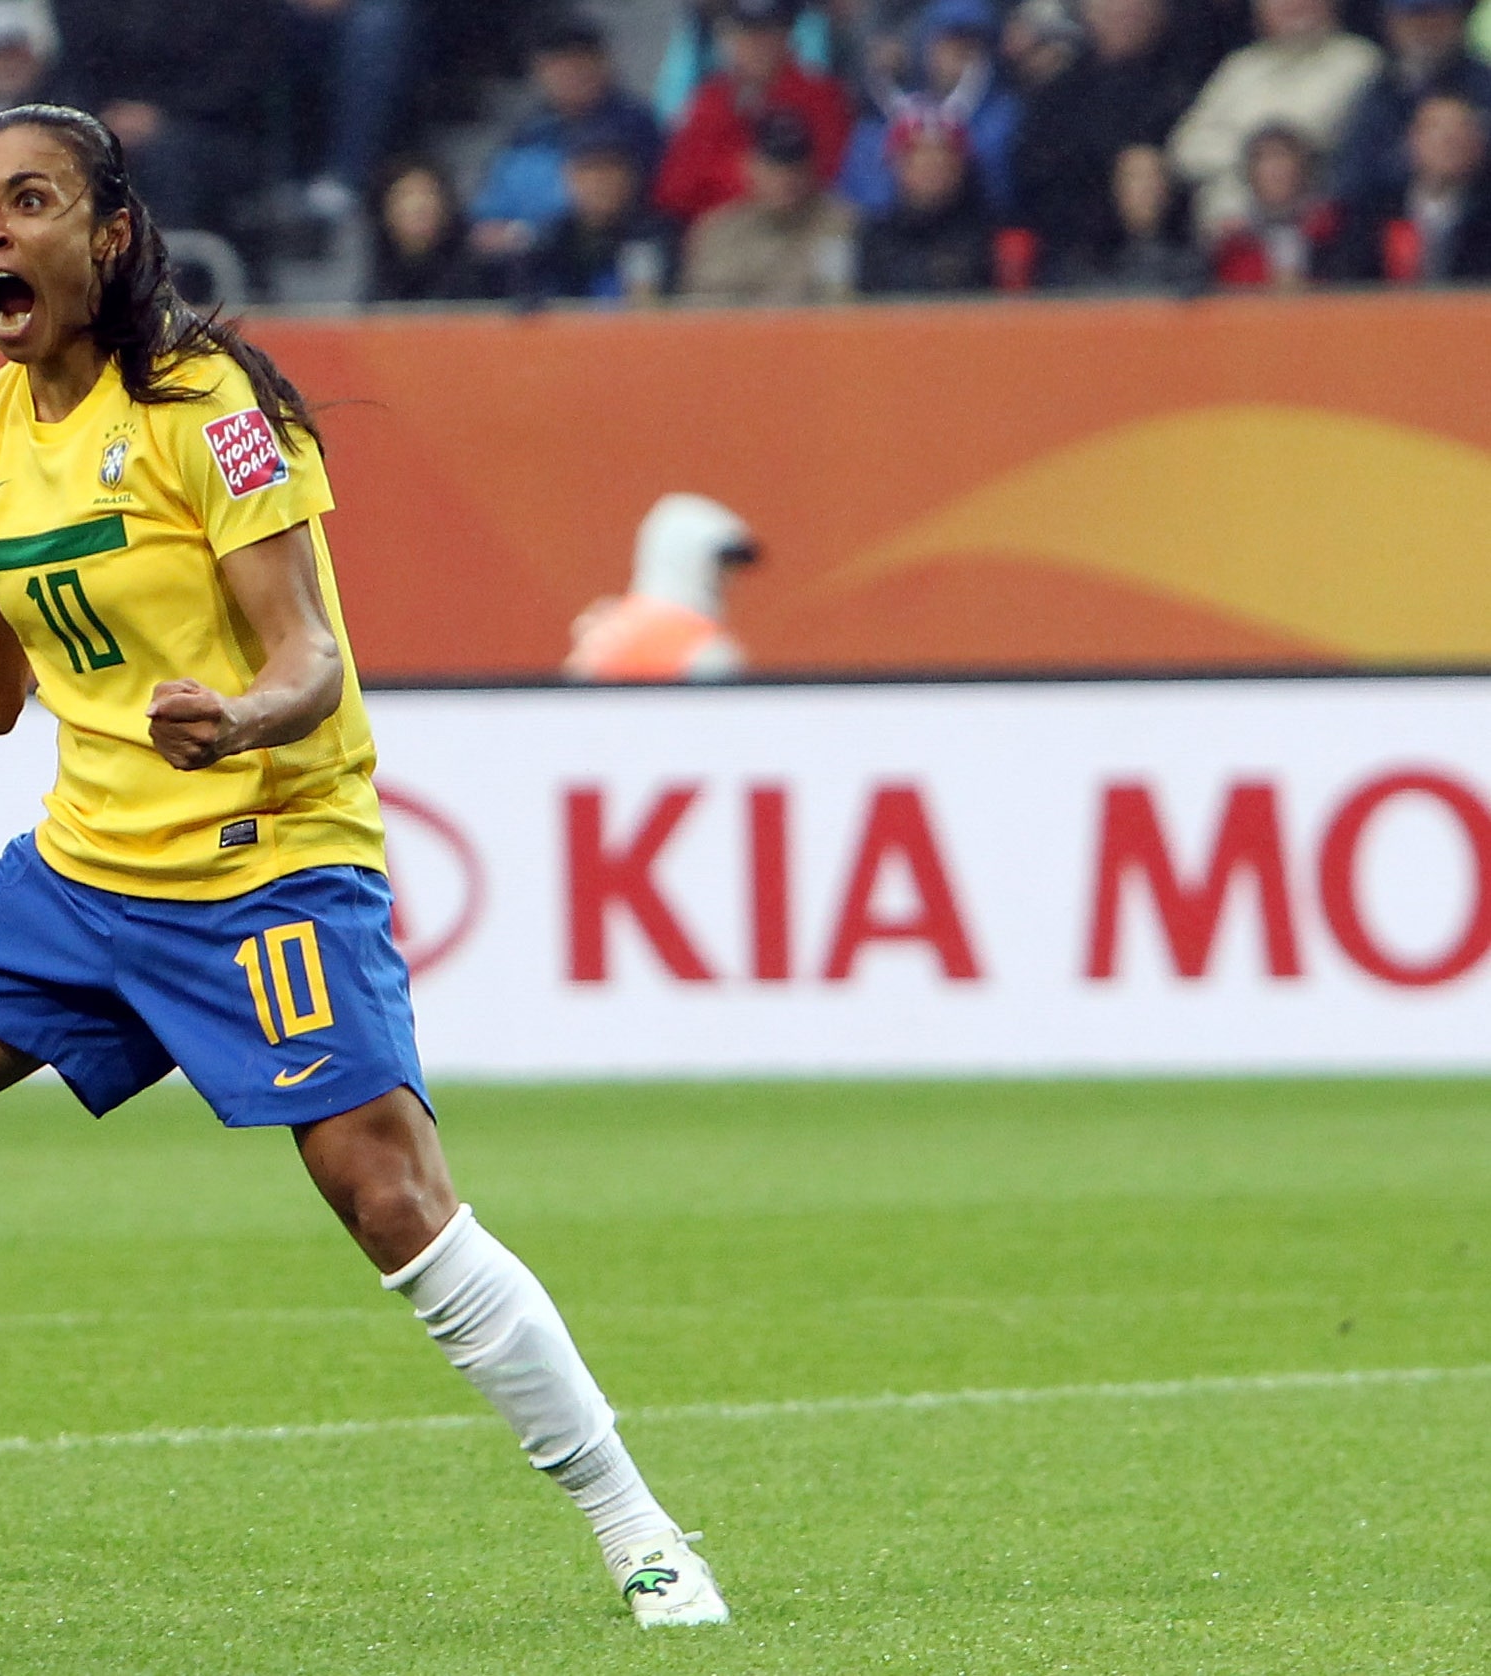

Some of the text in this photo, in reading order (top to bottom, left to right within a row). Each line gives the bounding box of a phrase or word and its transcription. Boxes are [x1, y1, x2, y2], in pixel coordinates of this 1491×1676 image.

[212, 414, 251, 451] LIVE
[219, 428, 268, 468] YOUR
[228, 441, 276, 487] GOALS
[26, 568, 125, 674] 10
[562, 783, 983, 983] KIA
[1082, 769, 1491, 989] MO
[233, 920, 335, 1046] 10
